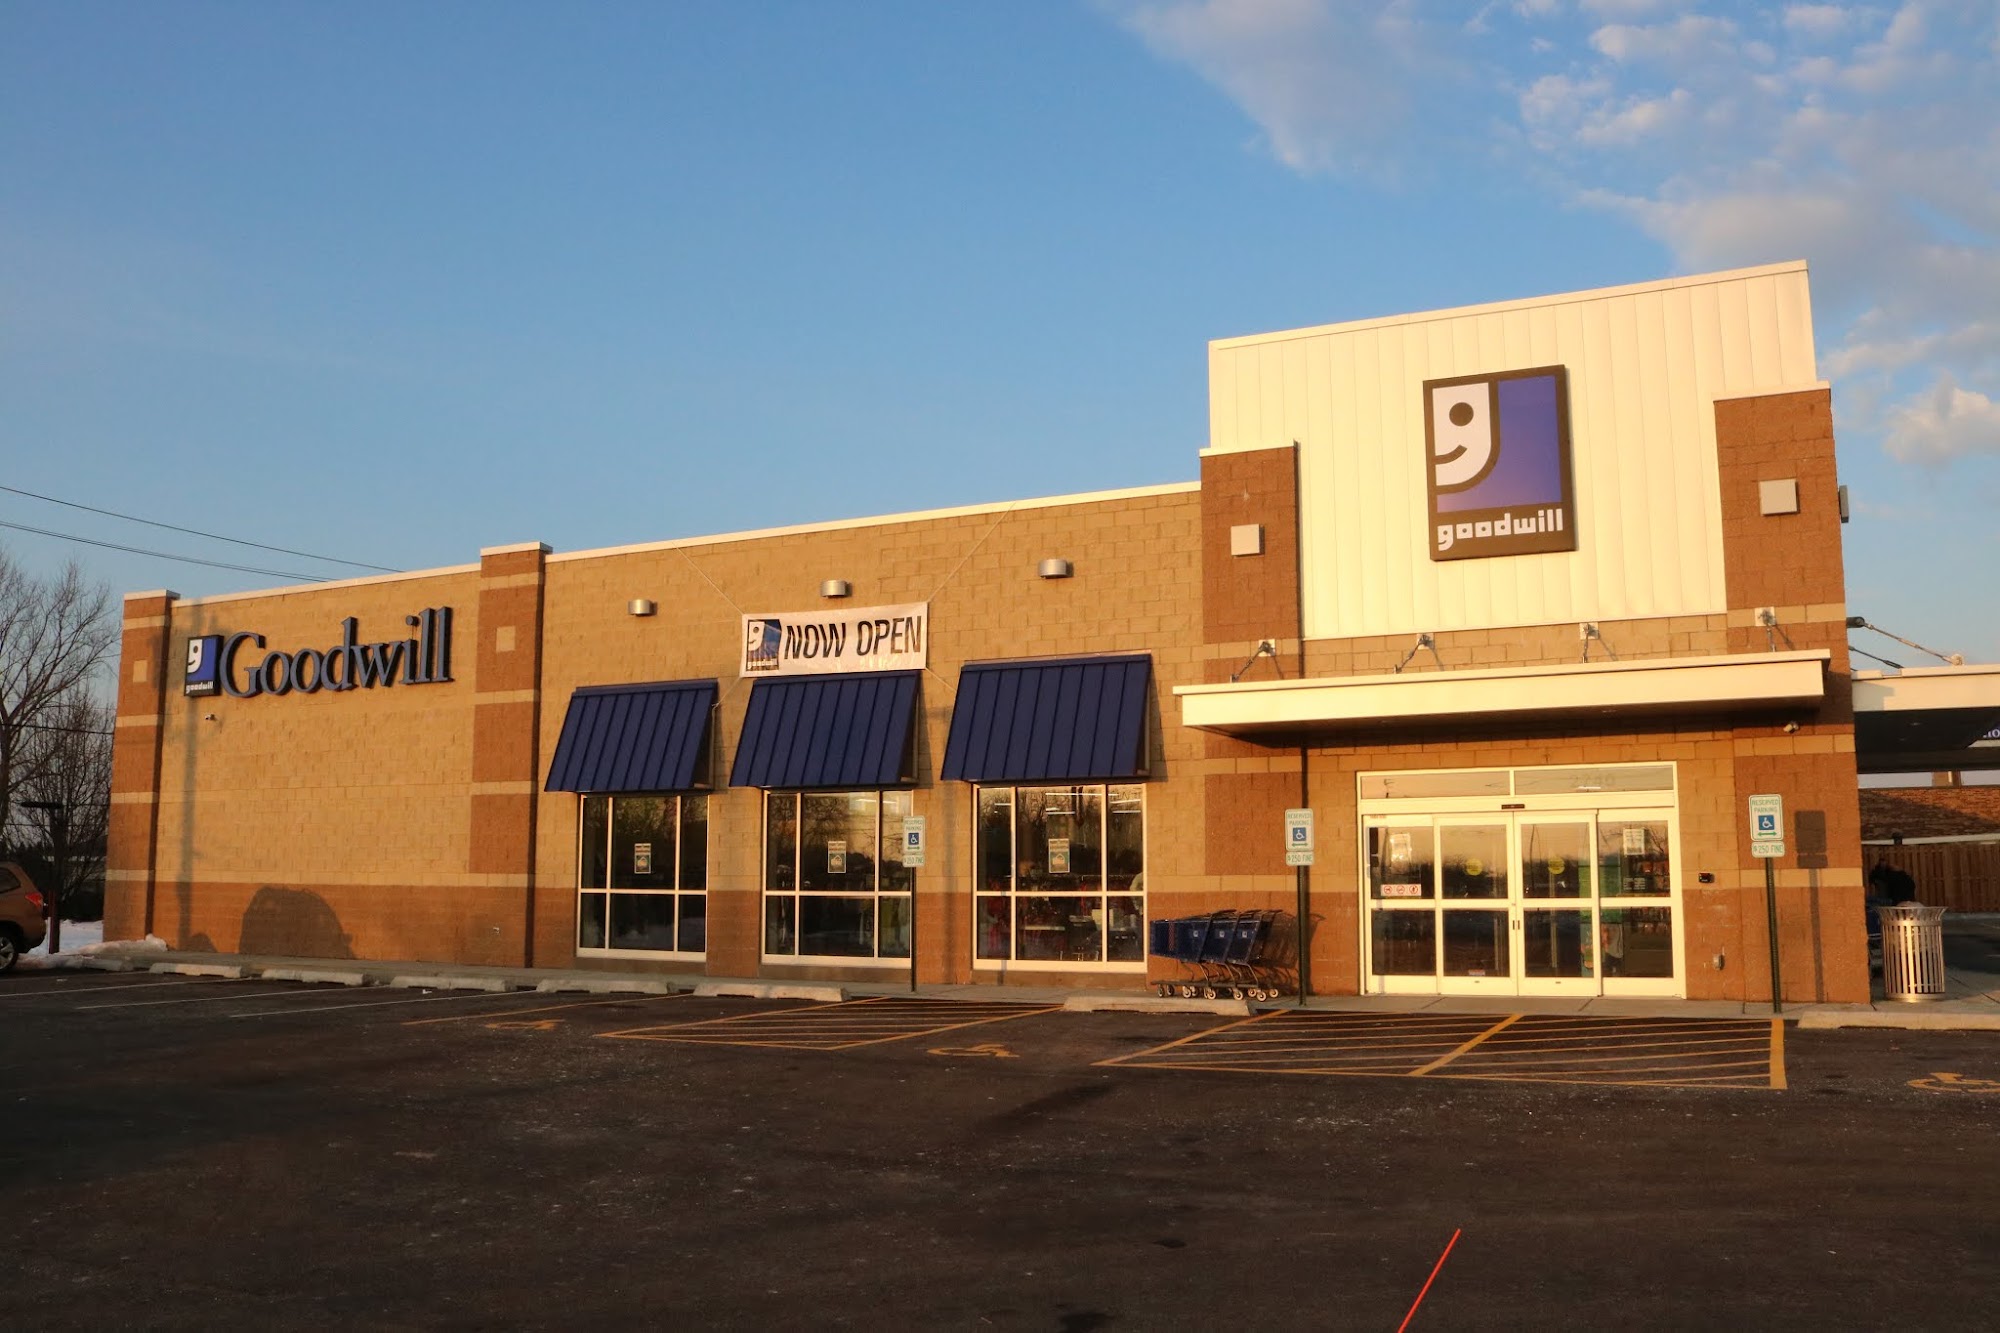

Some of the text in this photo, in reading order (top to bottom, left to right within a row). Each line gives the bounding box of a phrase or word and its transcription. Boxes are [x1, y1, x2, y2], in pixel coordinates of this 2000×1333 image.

[1437, 508, 1564, 552] goodwill
[218, 606, 455, 698] Goodwill
[784, 615, 922, 660] NOW OPEN
[185, 681, 214, 694] goodwill
